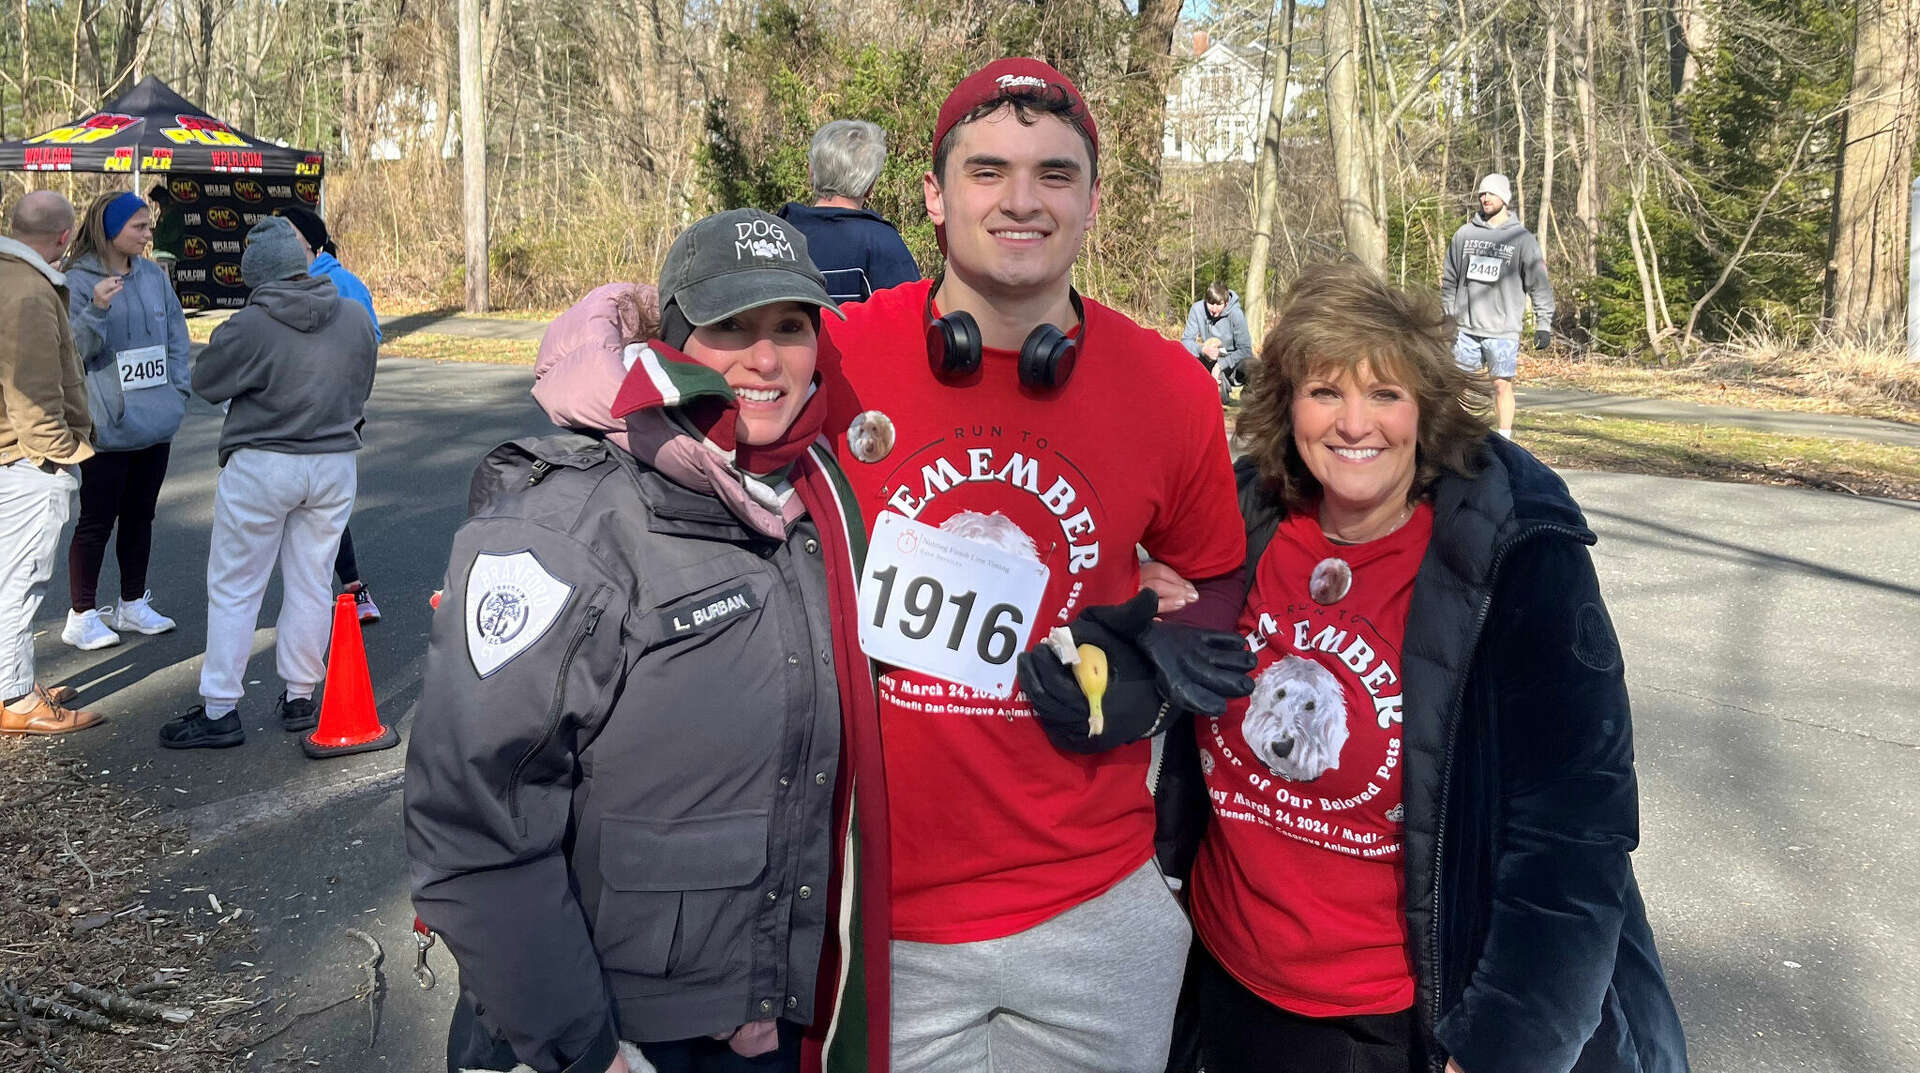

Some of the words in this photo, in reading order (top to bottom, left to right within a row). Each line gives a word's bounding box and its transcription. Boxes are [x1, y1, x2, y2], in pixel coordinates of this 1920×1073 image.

[24, 148, 72, 164] WPLR.COM
[141, 156, 173, 170] PLR
[211, 151, 263, 167] WPLR.COM
[295, 162, 320, 175] PLR
[208, 207, 230, 219] CHAZ
[735, 220, 787, 241] DOG
[215, 265, 238, 277] CHAZ
[1469, 263, 1499, 277] 2448
[121, 359, 165, 383] 2405
[954, 425, 1003, 439] RUN
[1021, 431, 1049, 449] TO
[887, 447, 1101, 575] EMEMBER
[1057, 581, 1083, 621] Pets
[871, 563, 1024, 666] 1916
[1245, 612, 1403, 729] EMEMBER
[881, 689, 889, 701] To
[890, 695, 922, 712] Benefit
[924, 703, 945, 713] Dan
[946, 704, 994, 716] Cosgrove
[900, 680, 944, 697] March
[948, 683, 969, 701] 24,
[1210, 715, 1243, 766] onor
[1249, 773, 1271, 791] of
[1276, 788, 1313, 809] Our
[1319, 781, 1382, 812] Beloved
[1376, 737, 1401, 781] Pets
[1233, 791, 1270, 817] March
[1275, 809, 1294, 828] 24,
[1297, 815, 1329, 835] 2024
[1220, 808, 1256, 822] Benefit
[1324, 841, 1360, 856] Animal
